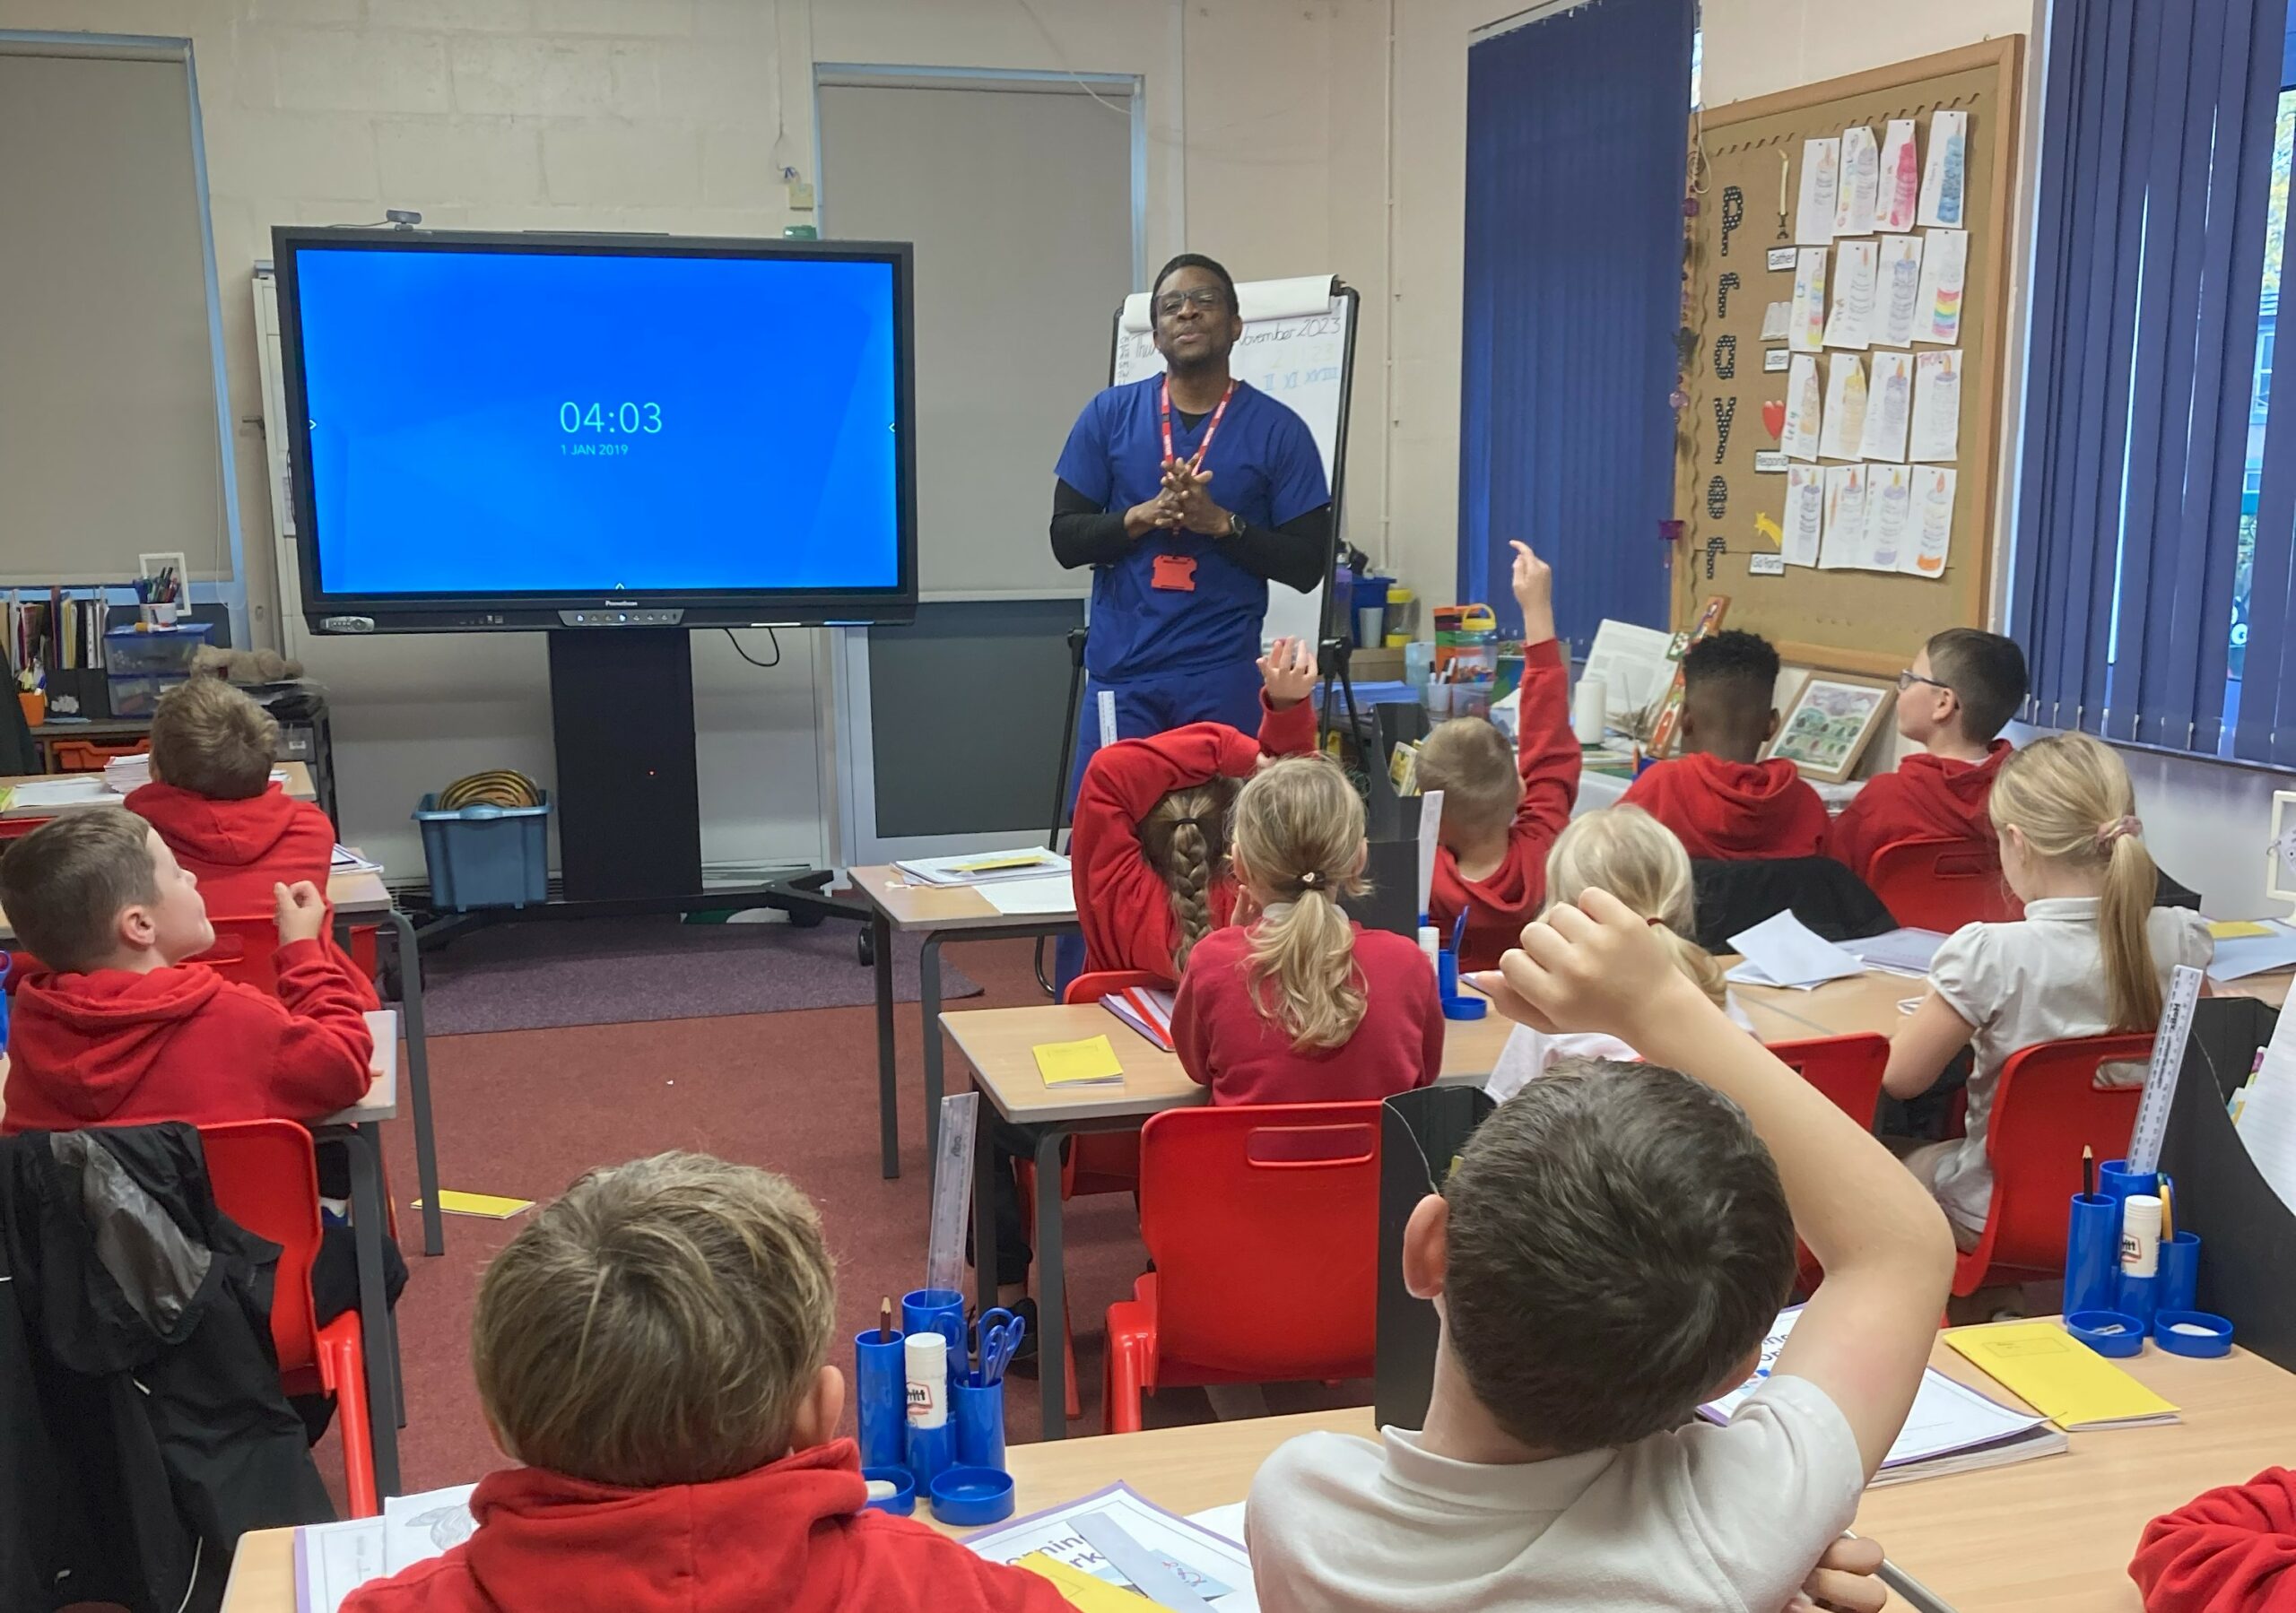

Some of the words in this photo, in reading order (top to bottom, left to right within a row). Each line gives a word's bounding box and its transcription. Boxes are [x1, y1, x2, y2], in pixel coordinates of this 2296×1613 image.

[1297, 317, 1341, 337] 2023
[560, 402, 662, 433] 04:03
[561, 444, 567, 455] 1
[570, 444, 596, 455] JAN
[598, 444, 629, 455] 2019
[2170, 1003, 2181, 1030] Helix
[2121, 1238, 2136, 1252] ritt
[906, 1388, 926, 1401] ritt
